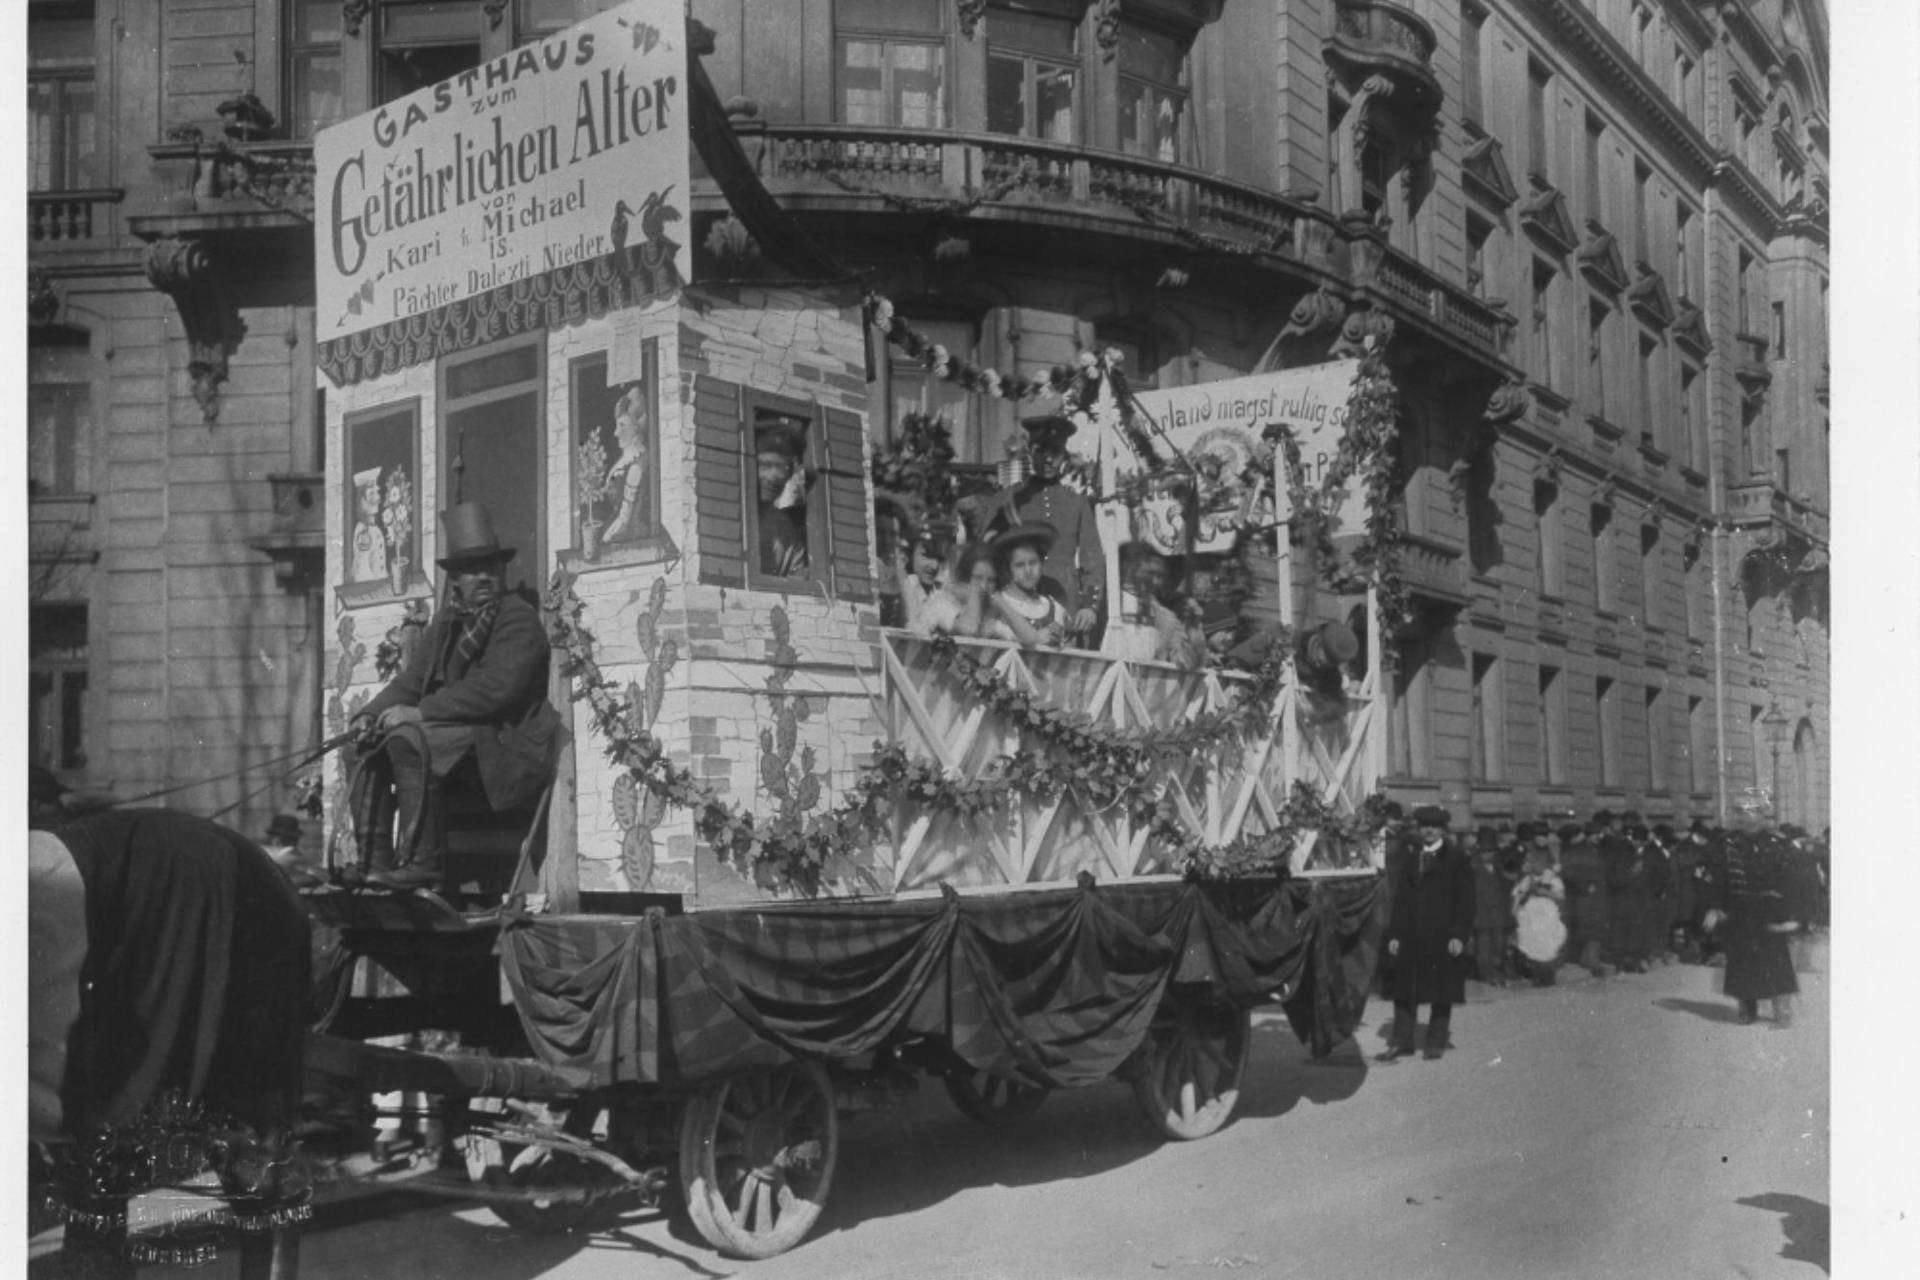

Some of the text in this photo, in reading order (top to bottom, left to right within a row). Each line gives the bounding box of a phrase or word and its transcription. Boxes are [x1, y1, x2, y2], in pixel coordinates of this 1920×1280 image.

[374, 32, 595, 148] GASTHAUS
[472, 87, 517, 115] zum
[332, 63, 676, 276] Gefährlichen Alter
[481, 192, 516, 211] von
[481, 178, 586, 241] Michael
[392, 282, 459, 318] Pächter
[1218, 387, 1278, 427] magst
[1280, 386, 1328, 434] ruhig
